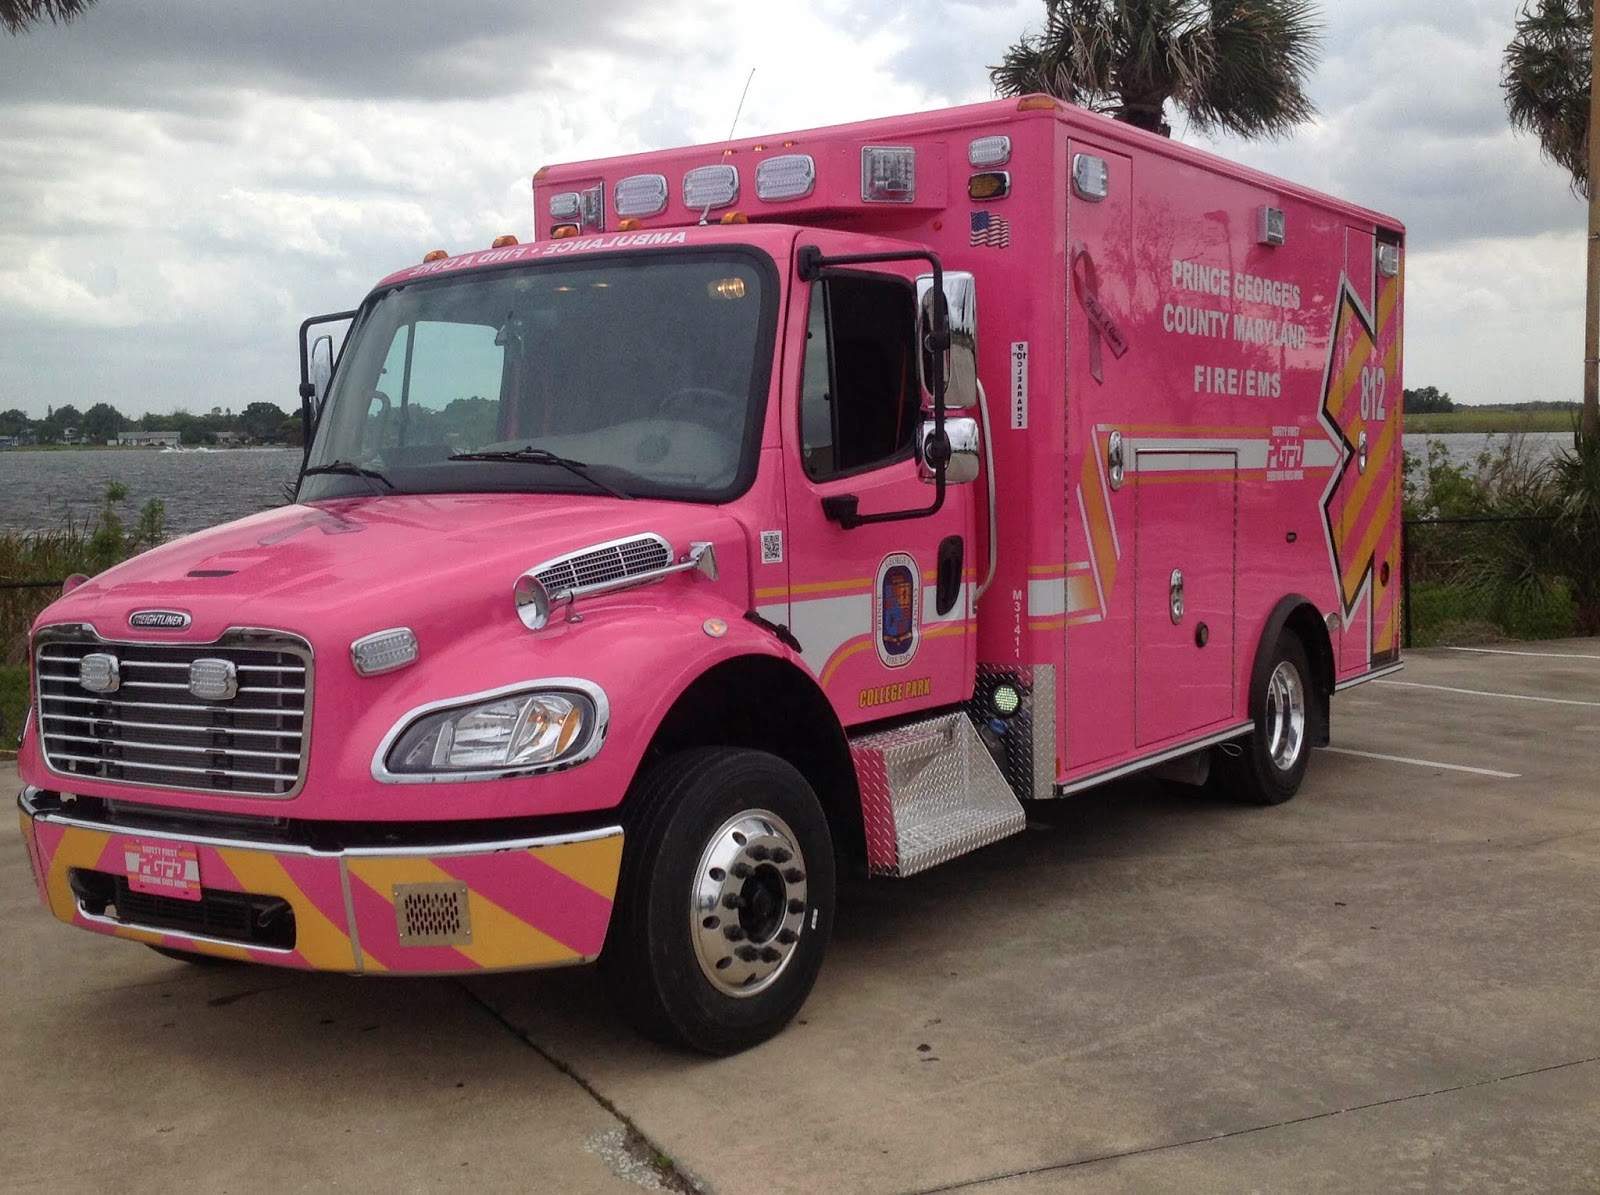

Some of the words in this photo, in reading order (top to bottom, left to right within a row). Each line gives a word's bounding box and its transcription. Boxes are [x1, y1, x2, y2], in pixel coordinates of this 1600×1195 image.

[1172, 259, 1230, 297] PRINCE
[1163, 303, 1230, 339] COUNTY
[1233, 314, 1306, 350] MARYLAND
[1194, 365, 1281, 398] FIRE/EMS
[1360, 366, 1386, 422] 812
[132, 614, 183, 625] FREIGHTLINER
[1013, 590, 1022, 658] M31411
[859, 683, 902, 708] COLLEGE
[905, 678, 931, 701] PARK
[142, 845, 161, 855] SAFETY
[162, 848, 177, 857] FIRST
